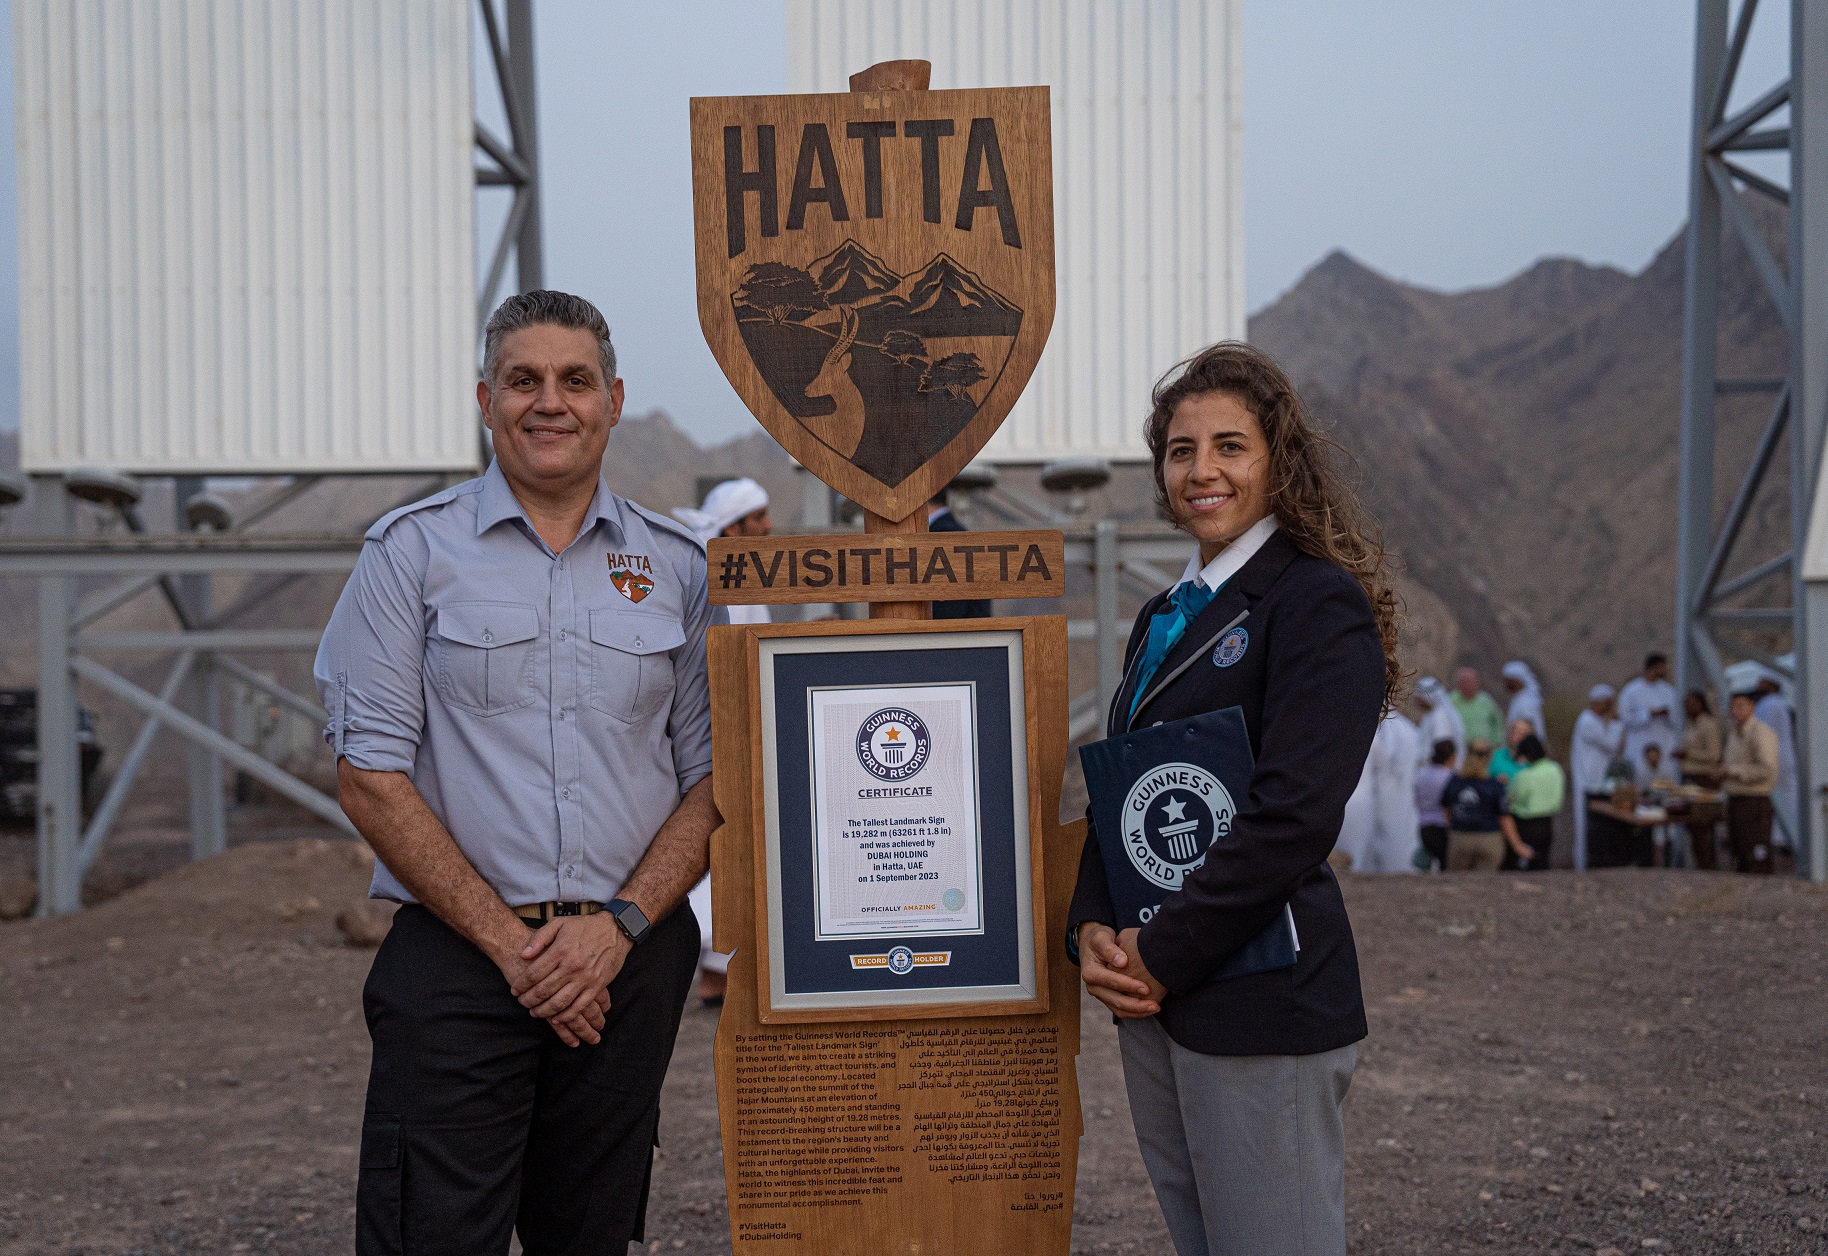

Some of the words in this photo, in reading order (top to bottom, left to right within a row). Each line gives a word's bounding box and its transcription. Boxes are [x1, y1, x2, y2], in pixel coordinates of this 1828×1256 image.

[723, 117, 1022, 259] HATTA
[606, 552, 653, 575] HATTA
[720, 543, 1053, 589] #VISITHATTA
[866, 711, 920, 733] GUINNESS
[860, 741, 886, 776] WORLD
[890, 738, 927, 778] RECORDS
[857, 786, 933, 798] CERTIFICATE
[1133, 771, 1214, 812] GUINNESS
[847, 819, 862, 827] The
[862, 818, 889, 827] Tallest
[889, 816, 927, 826] Landmark
[928, 816, 945, 826] Sign
[842, 831, 850, 839] is
[888, 828, 918, 839] (63261
[918, 828, 926, 836] ft
[926, 827, 939, 836] 1.8
[940, 826, 952, 836] in)
[859, 840, 874, 849] and
[891, 839, 925, 848] achieved
[926, 839, 936, 848] by
[867, 852, 892, 860] DUBAI
[893, 850, 929, 859] HOLDING
[1129, 828, 1175, 881] WORLD
[882, 862, 906, 871] Hatta,
[907, 861, 924, 870] UAE
[869, 874, 875, 882] 1
[875, 873, 918, 884] September
[918, 872, 939, 881] 2023
[735, 1034, 746, 1043] By
[748, 1033, 778, 1042] setting
[778, 1032, 793, 1040] the
[794, 1031, 833, 1040] Guinness
[864, 1050, 896, 1059] striking
[735, 1065, 767, 1074] symbol
[767, 1064, 777, 1072] of
[880, 1060, 896, 1068] and
[841, 1072, 876, 1080] Located
[735, 1085, 788, 1095] strategically
[818, 1083, 848, 1091] summit
[850, 1082, 859, 1090] of
[736, 1096, 759, 1106] Hajar
[828, 1093, 867, 1101] elevation
[868, 1092, 878, 1100] of
[736, 1106, 797, 1116] approximately
[864, 1102, 900, 1111] standing
[758, 1116, 806, 1124] astounding
[807, 1115, 834, 1124] height
[846, 1113, 868, 1121] 19.28
[736, 1127, 756, 1136] This
[756, 1126, 825, 1135] record-breaking
[867, 1123, 882, 1131] will
[737, 1138, 780, 1146] testament
[842, 1135, 872, 1143] beauty
[873, 1134, 889, 1142] and
[737, 1149, 769, 1157] cultural
[770, 1148, 806, 1156] heritage
[831, 1145, 871, 1154] providing
[768, 1157, 826, 1167] unforgettable
[780, 1168, 821, 1177] highlands
[861, 1165, 885, 1173] invite
[737, 1180, 762, 1188] world
[807, 1177, 824, 1186] this
[824, 1176, 867, 1185] incredible
[886, 1175, 902, 1183] and
[789, 1189, 811, 1198] pride
[838, 1187, 870, 1195] achieve
[872, 1186, 888, 1194] this
[738, 1200, 790, 1209] monumental
[739, 1221, 787, 1231] #VisitHatta
[739, 1232, 802, 1241] #DubaiHolding
